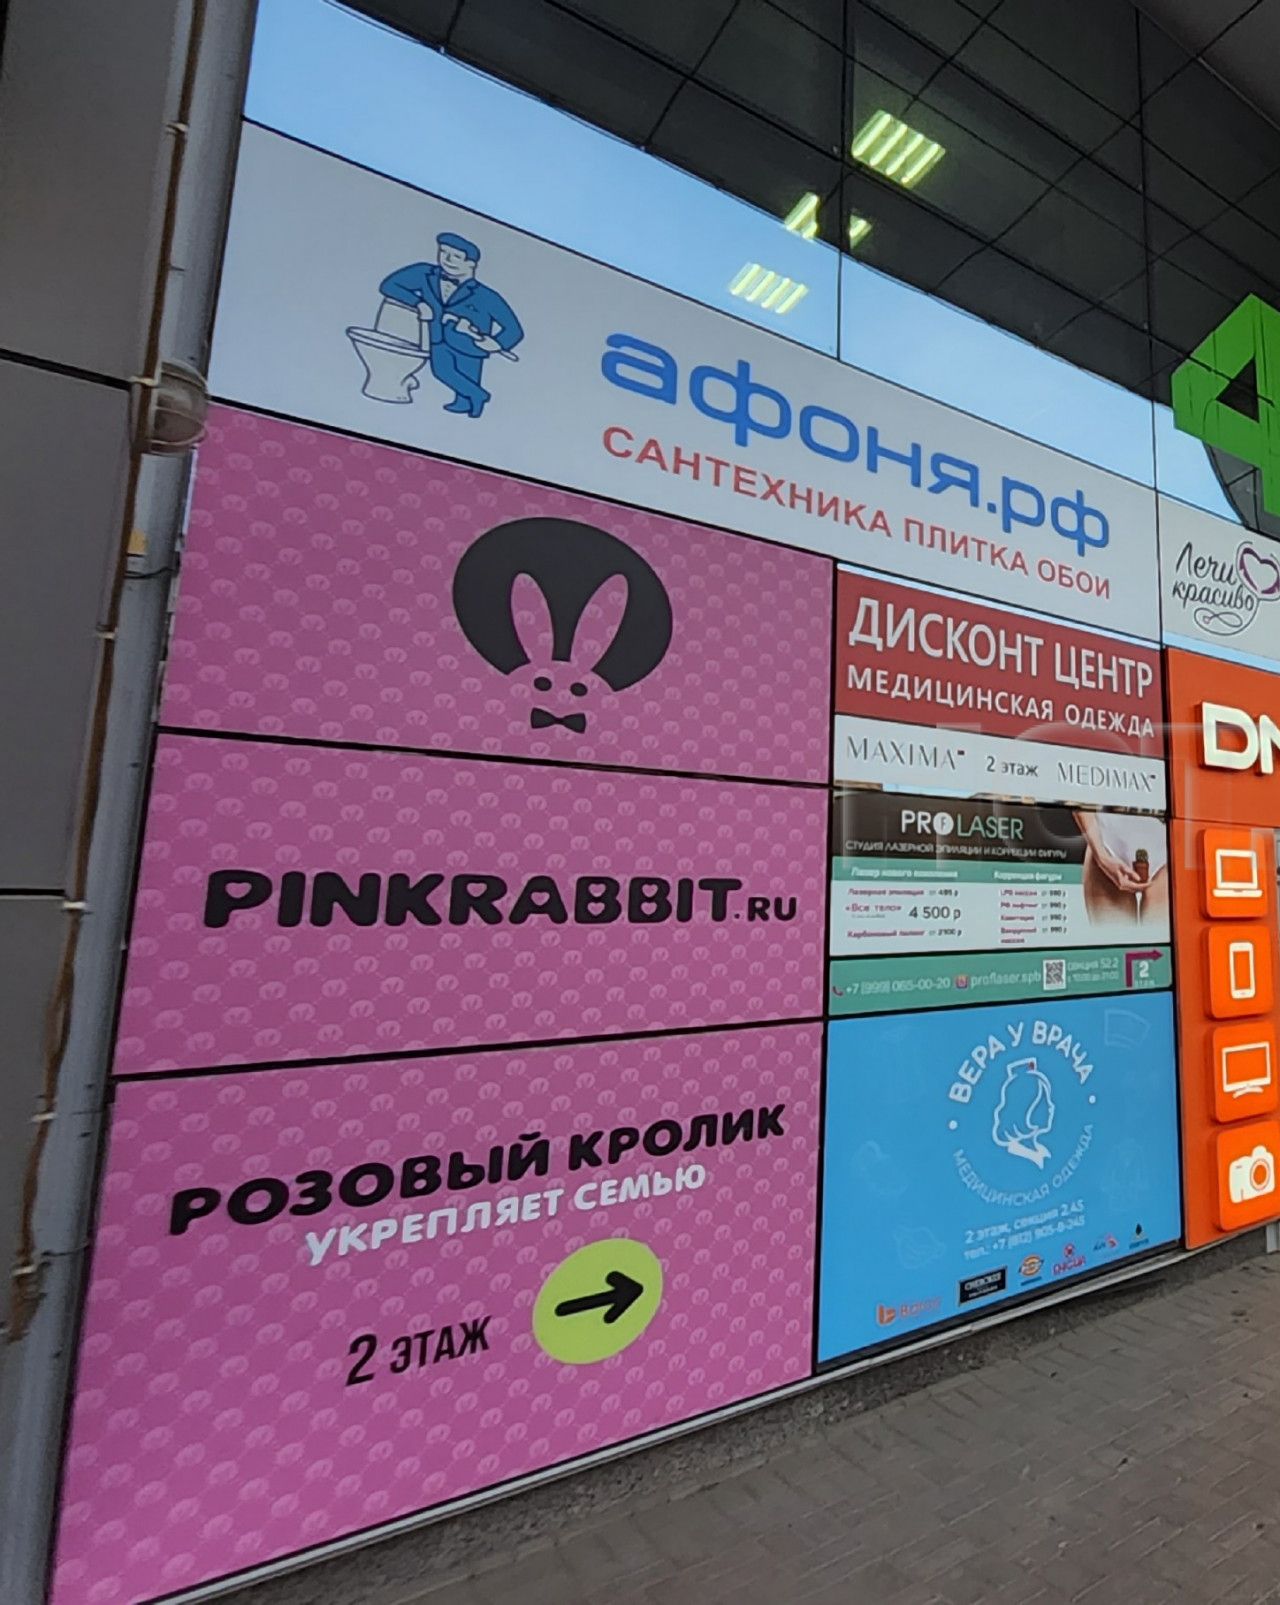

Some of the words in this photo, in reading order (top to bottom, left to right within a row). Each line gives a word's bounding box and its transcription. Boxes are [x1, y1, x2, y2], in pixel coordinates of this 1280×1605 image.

[601, 333, 1110, 557] афоня.рф
[602, 426, 892, 538] САНТЕХНИКА
[904, 516, 1029, 577] ПЛИТКА
[1037, 558, 1111, 600] ОБОИ
[1172, 577, 1255, 612] красиво
[1175, 542, 1237, 585] Лечи
[849, 597, 1044, 677] ДИСКОНТ
[1054, 642, 1153, 698] ЦЕНТР
[847, 664, 1054, 722] МЕДИЦИНСКАЯ
[1065, 703, 1155, 739] ОДЕЖДА
[847, 735, 957, 772] MAXIMA
[986, 755, 997, 774] 2
[1001, 759, 1039, 778] этаж
[1057, 761, 1153, 793] MEDIMAX
[956, 814, 1024, 841] LASER
[203, 869, 797, 928] PINKRABBIT.RU
[909, 906, 918, 919] 4
[922, 905, 950, 919] 500
[1139, 960, 1149, 978] 2
[948, 1034, 1006, 1104] ВЕРА
[1007, 1021, 1025, 1047] У
[1031, 1020, 1094, 1085] ВРАЧА
[168, 1130, 550, 1236] РОЗОВЫЙ
[567, 1103, 786, 1170] КРОЛИК
[1051, 1123, 1094, 1190] ОДЕЖДА
[304, 1187, 562, 1266] УКРЕПЛЯЕТ
[572, 1163, 707, 1211] СЕМЬЮ
[345, 1332, 379, 1387] 2
[389, 1315, 493, 1375] ЭТАЖ
